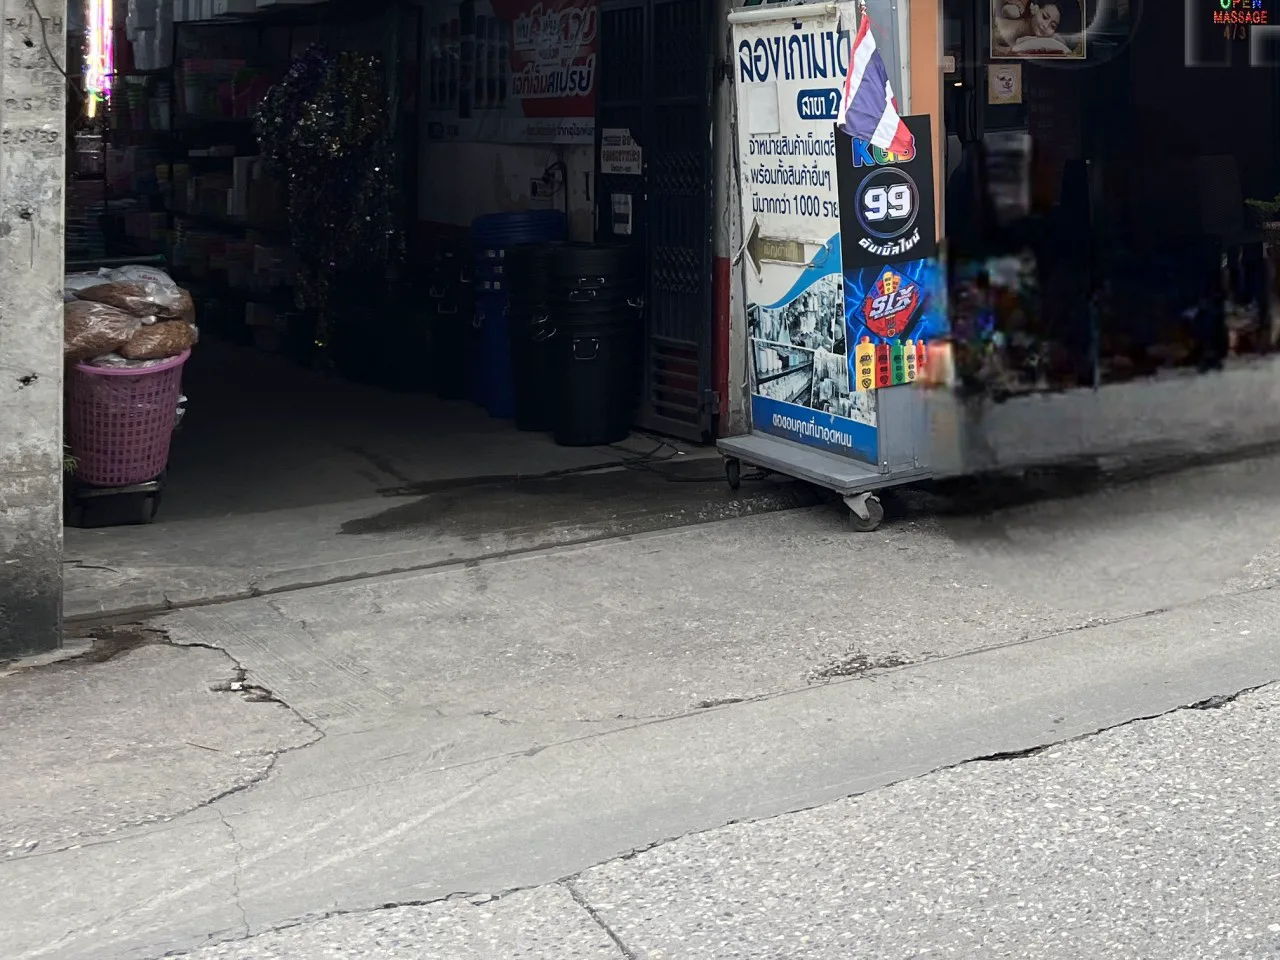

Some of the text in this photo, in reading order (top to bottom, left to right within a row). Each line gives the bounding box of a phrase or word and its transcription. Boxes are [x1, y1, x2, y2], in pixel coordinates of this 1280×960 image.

[1213, 10, 1268, 24] MASSAGE
[801, 91, 838, 116] สาขา 2
[793, 194, 820, 217] 1000
[863, 182, 913, 222] 99
